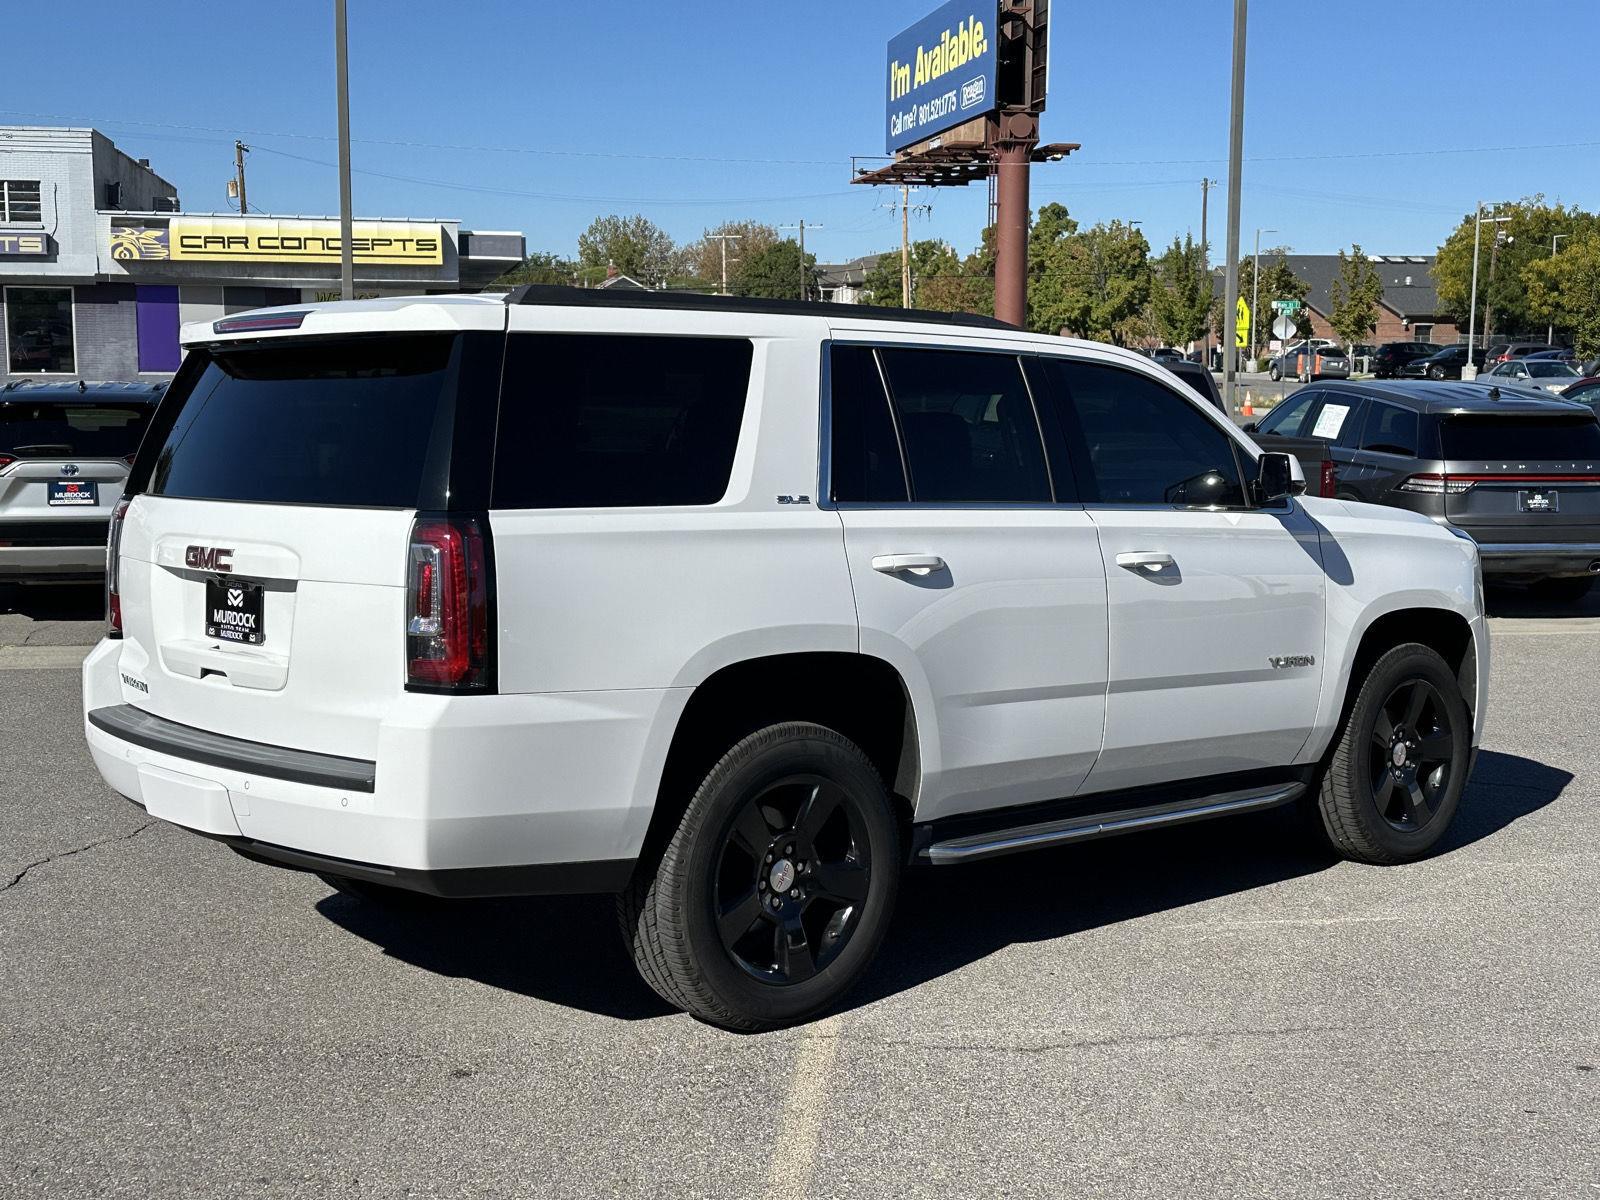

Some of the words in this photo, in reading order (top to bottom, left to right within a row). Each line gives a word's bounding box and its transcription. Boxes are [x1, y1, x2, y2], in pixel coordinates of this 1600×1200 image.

[891, 60, 911, 101] I'm
[914, 15, 987, 89] Available.
[891, 111, 902, 137] Call
[903, 104, 917, 132] me?
[180, 235, 249, 249] CAR
[258, 236, 437, 252] CONCEPTS
[185, 545, 235, 572] GMC
[214, 609, 256, 628] MURDOCK
[220, 630, 243, 640] MURDOCK
[1268, 655, 1315, 669] YUKON
[776, 862, 790, 890] GMC
